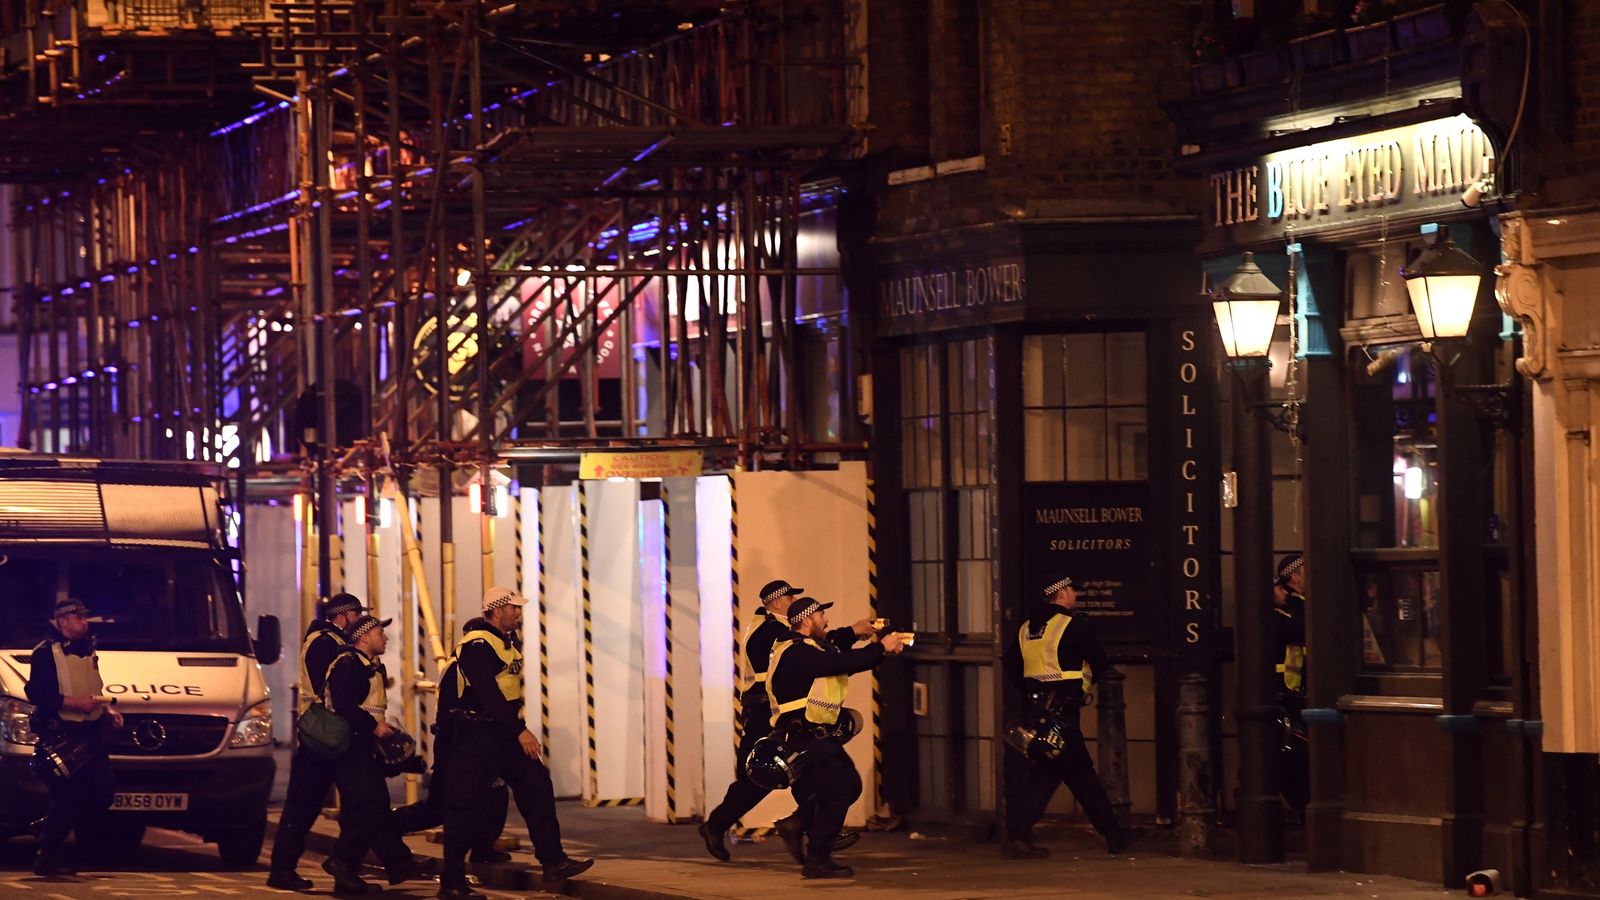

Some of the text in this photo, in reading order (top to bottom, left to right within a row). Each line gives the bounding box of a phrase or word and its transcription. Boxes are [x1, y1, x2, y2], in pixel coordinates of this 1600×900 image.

[1210, 128, 1484, 227] THE BLUE EYED MAID
[880, 263, 1023, 317] MAUNSELL BOWER
[1179, 330, 1201, 644] SOLICITORS
[1036, 507, 1144, 523] MAUNSELL BOWER
[1050, 538, 1132, 551] SOLICITORS
[105, 683, 204, 697] OLICE
